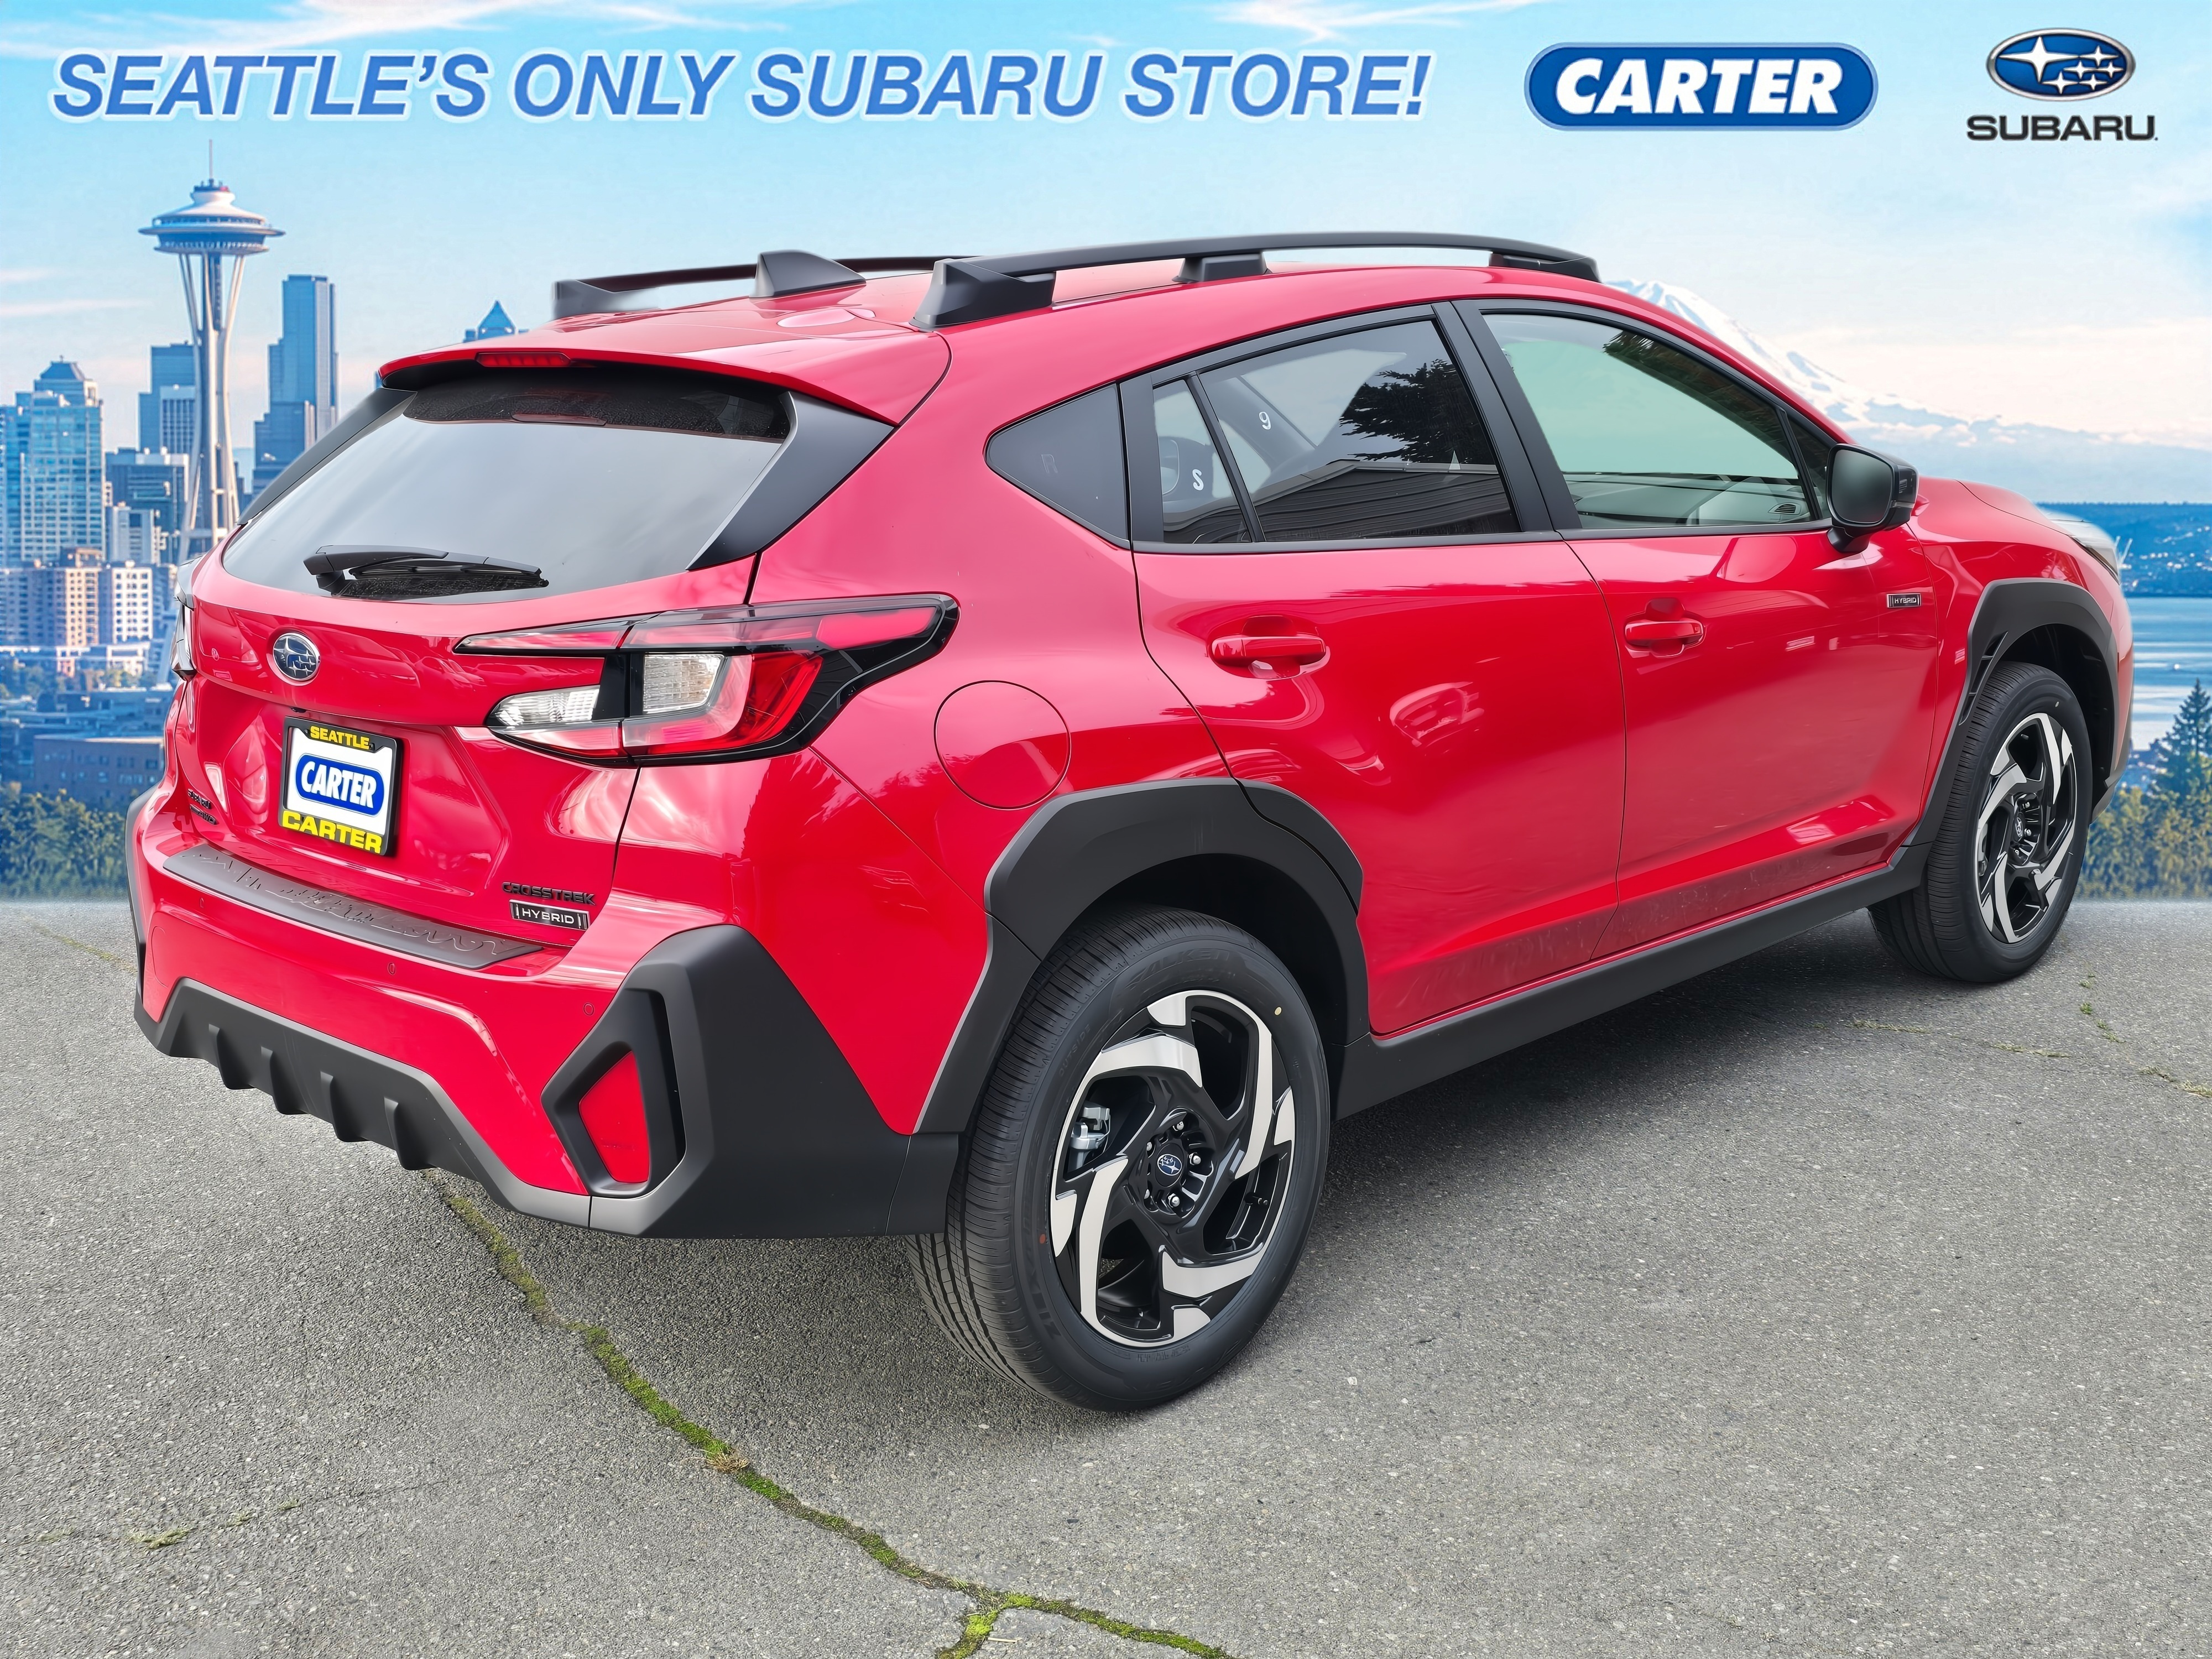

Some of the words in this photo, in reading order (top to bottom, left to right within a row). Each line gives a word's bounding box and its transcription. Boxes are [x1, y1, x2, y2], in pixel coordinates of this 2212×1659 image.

[310, 726, 371, 750] SEATTLE
[301, 761, 377, 808] CARTER
[282, 810, 382, 854] CARTER
[502, 881, 596, 905] CROSSTREK
[521, 907, 574, 924] HYBRID
